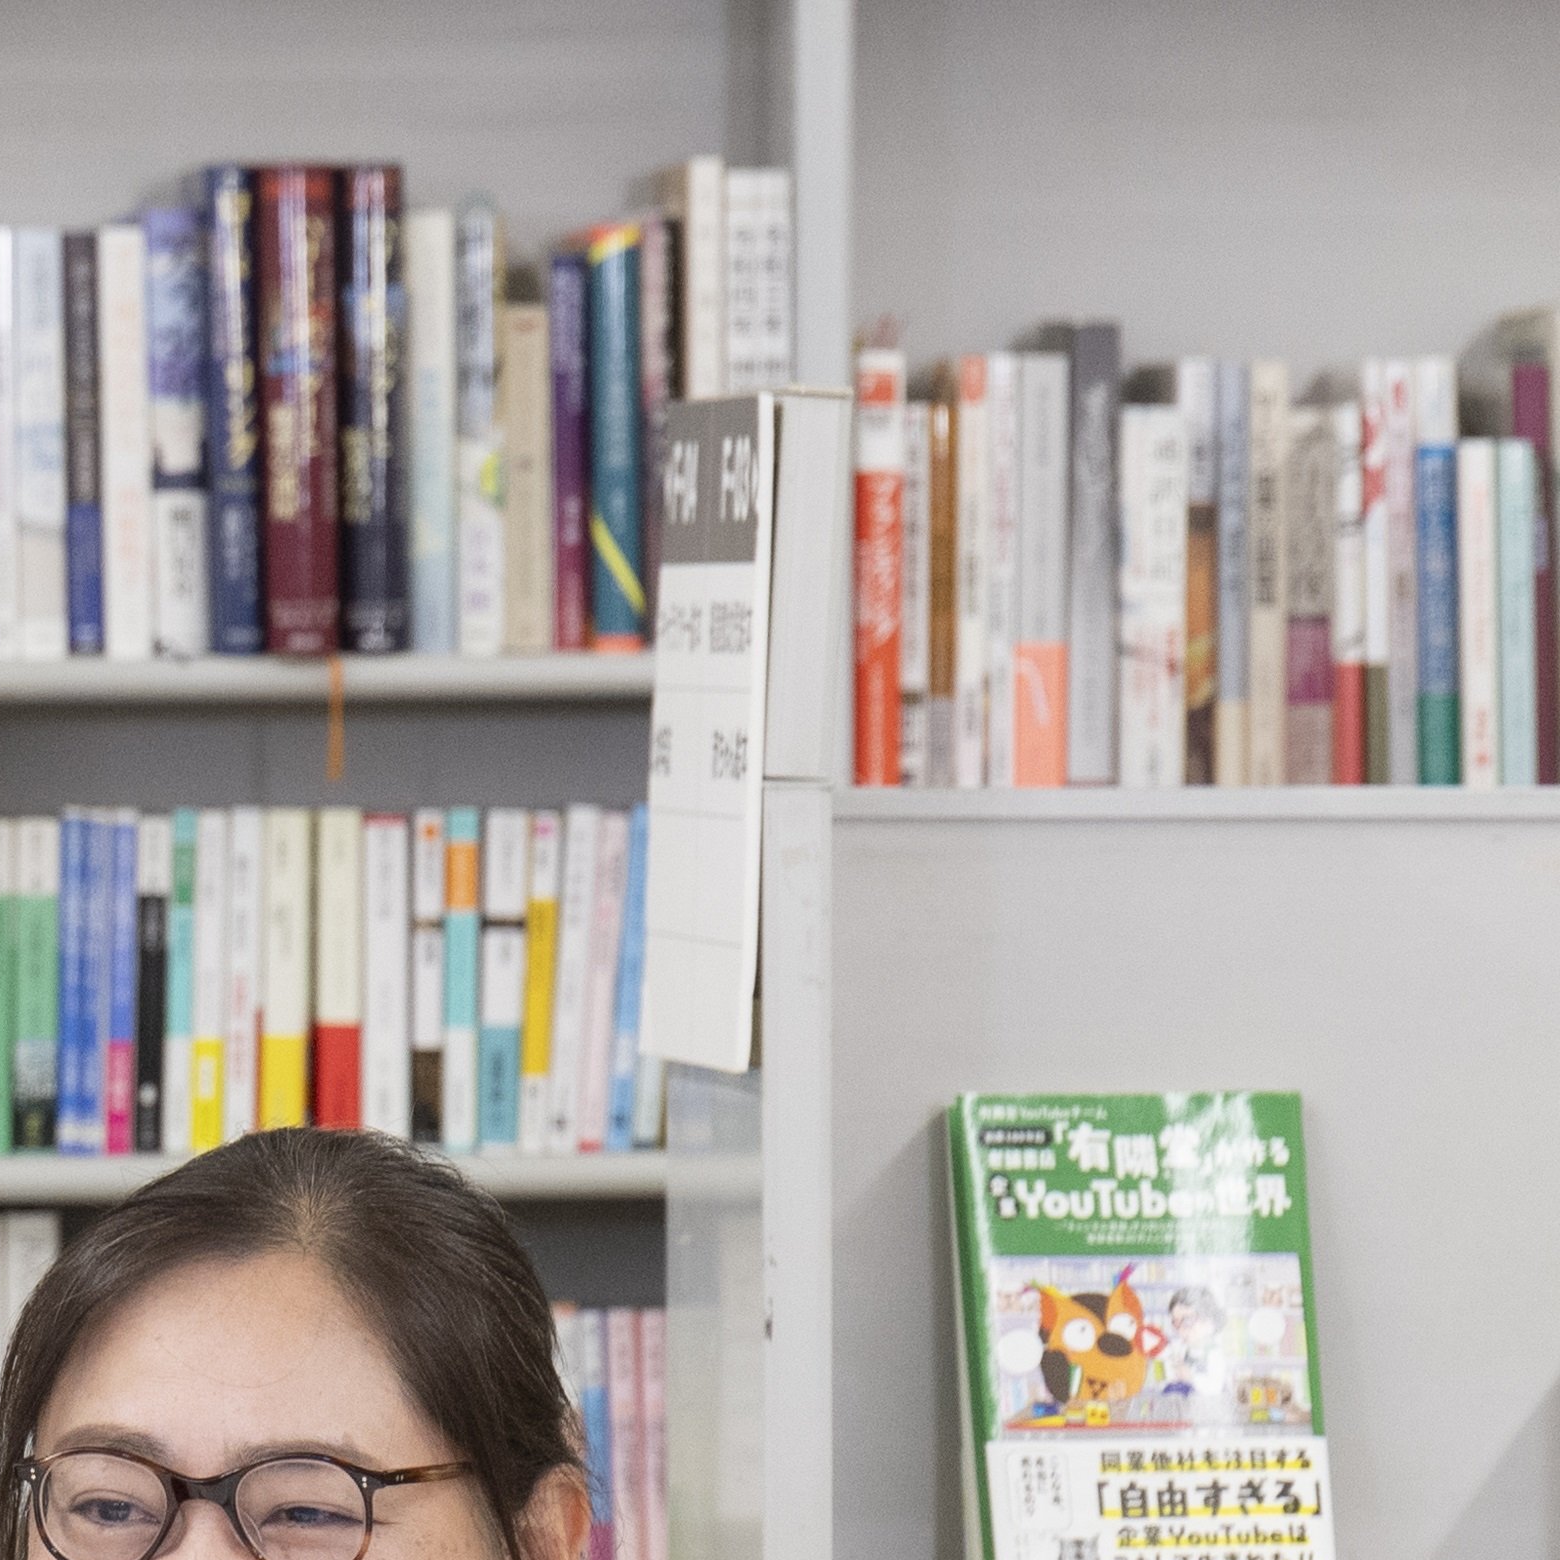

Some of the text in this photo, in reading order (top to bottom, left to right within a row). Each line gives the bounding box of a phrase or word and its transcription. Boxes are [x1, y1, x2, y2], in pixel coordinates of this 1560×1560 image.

[1096, 1479, 1322, 1517] 「自由すぎる」
[1117, 1523, 1308, 1546] 企業YouTubeは
